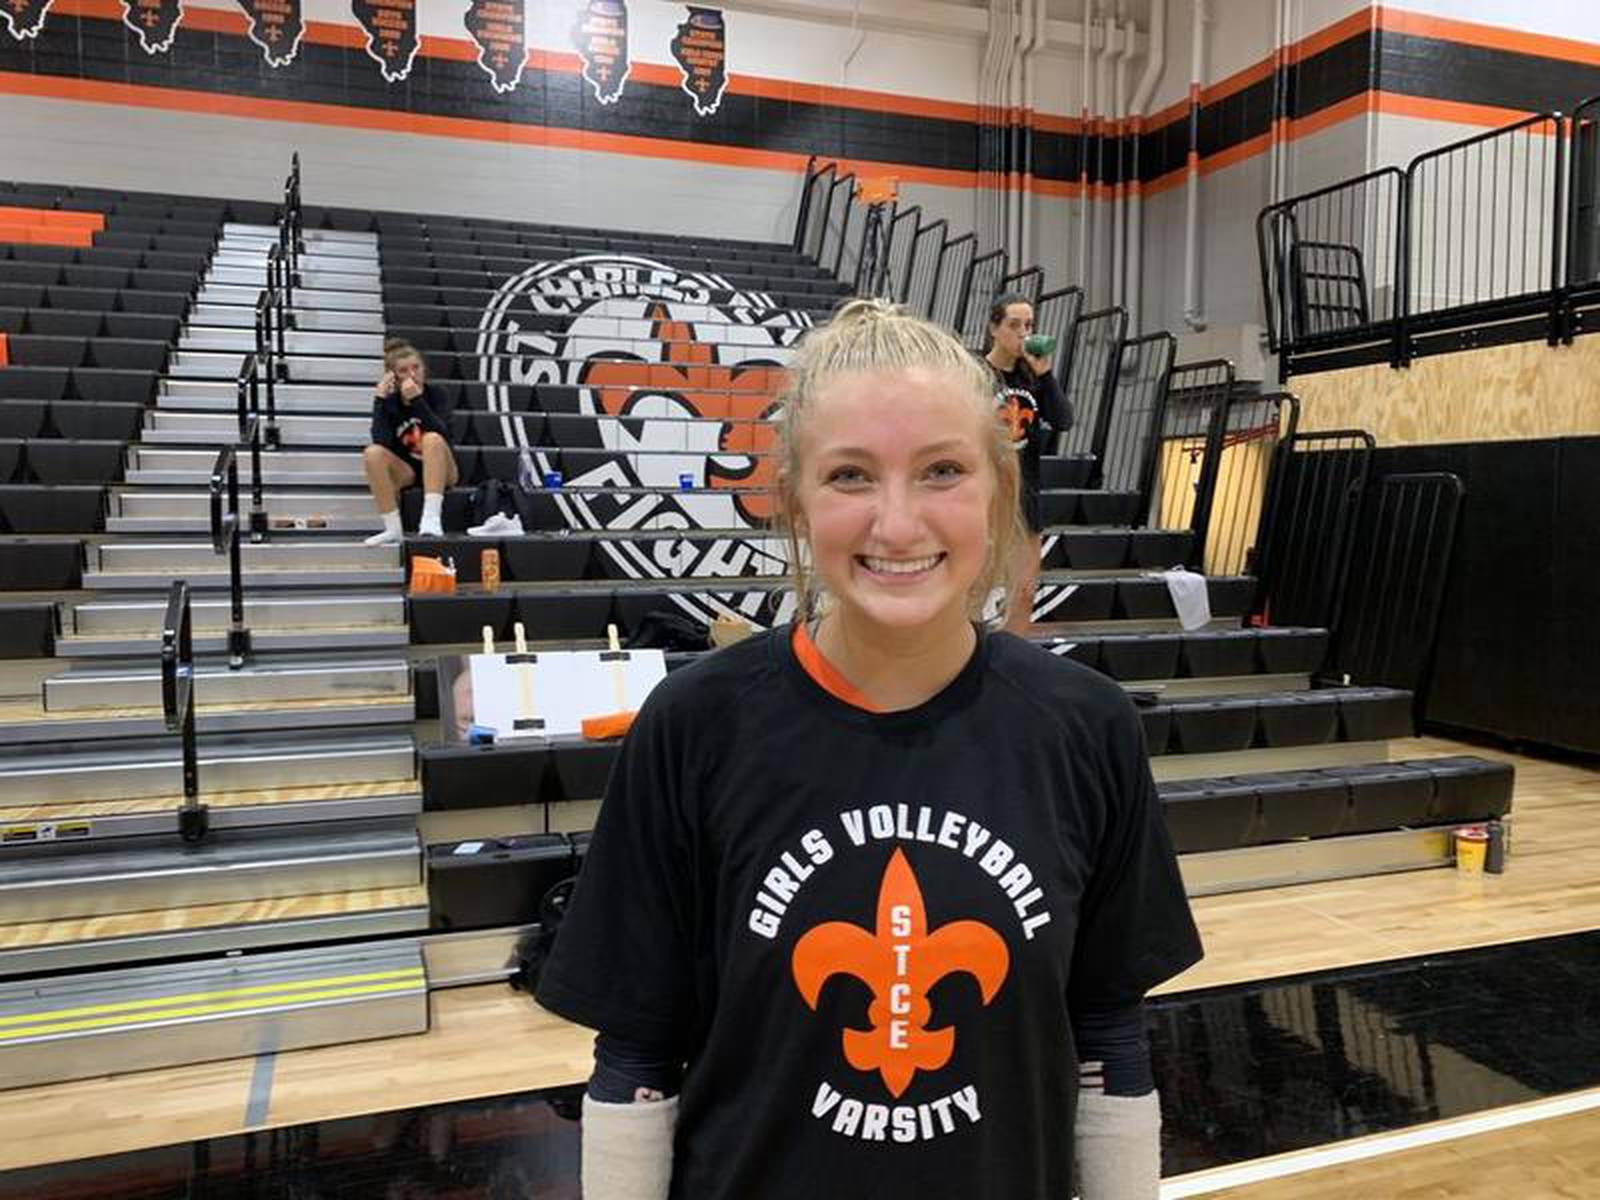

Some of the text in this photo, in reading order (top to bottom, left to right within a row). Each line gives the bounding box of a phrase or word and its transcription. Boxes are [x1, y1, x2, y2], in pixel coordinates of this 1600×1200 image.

[528, 265, 711, 315] CHARLES
[749, 803, 1051, 940] GIRLS VOLLEYBALL
[889, 905, 911, 1049] STCE
[811, 1082, 982, 1143] VARSITY
